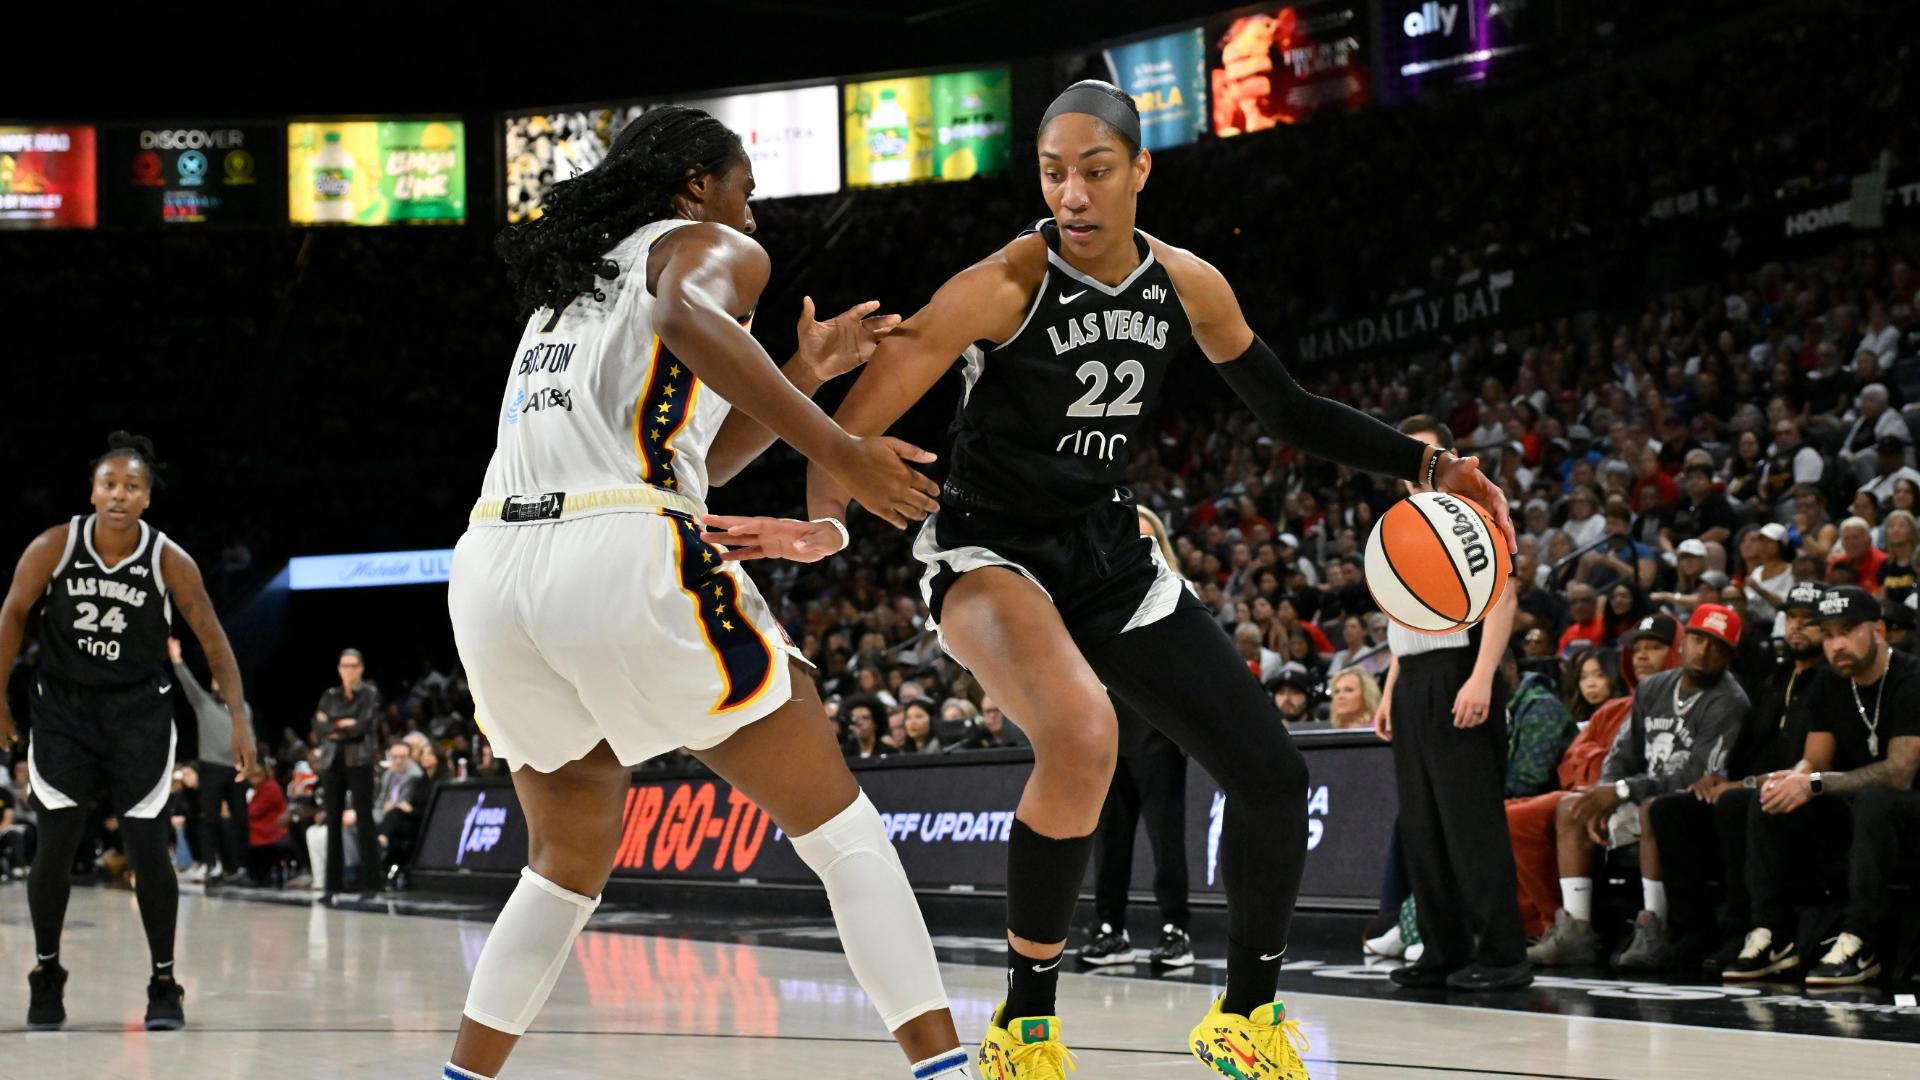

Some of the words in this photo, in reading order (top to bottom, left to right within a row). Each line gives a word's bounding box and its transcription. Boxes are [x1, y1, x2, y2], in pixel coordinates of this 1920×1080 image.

[1403, 1, 1458, 37] ally
[140, 129, 244, 150] DISCOVER
[1785, 199, 1853, 238] HOME
[1142, 285, 1167, 303] ally
[1047, 313, 1100, 355] LAS
[1103, 310, 1169, 350] VEGAS
[1298, 299, 1443, 361] MANDALAY
[1453, 286, 1504, 324] BAY
[1066, 359, 1145, 417] 22
[1432, 496, 1489, 577] Wilson
[129, 565, 149, 578] ally
[66, 577, 97, 597] LAS
[98, 579, 147, 607] VEGAS
[73, 602, 128, 634] 24
[77, 636, 121, 661] ring
[465, 826, 501, 852] APP
[612, 786, 664, 869] UR
[652, 783, 770, 874] GO-TO
[880, 812, 921, 842] OFF
